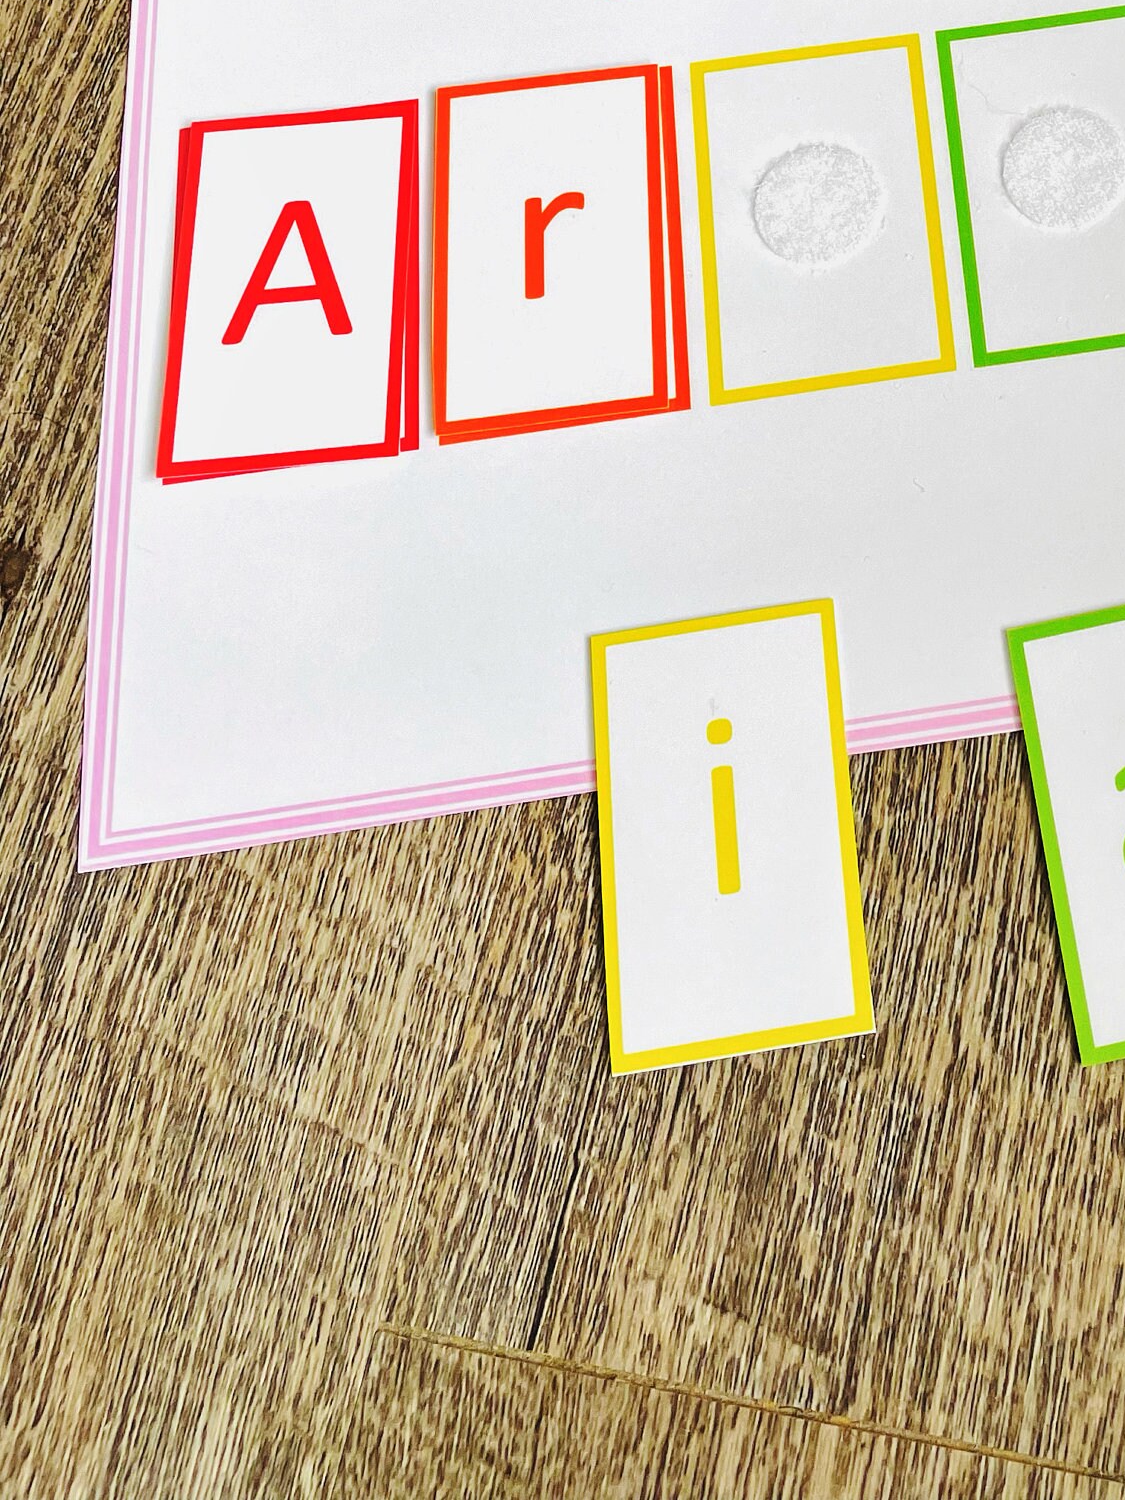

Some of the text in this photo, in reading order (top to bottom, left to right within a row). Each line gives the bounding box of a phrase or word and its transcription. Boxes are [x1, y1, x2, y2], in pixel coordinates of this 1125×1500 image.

[221, 190, 586, 346] A r
[705, 717, 742, 896] i
